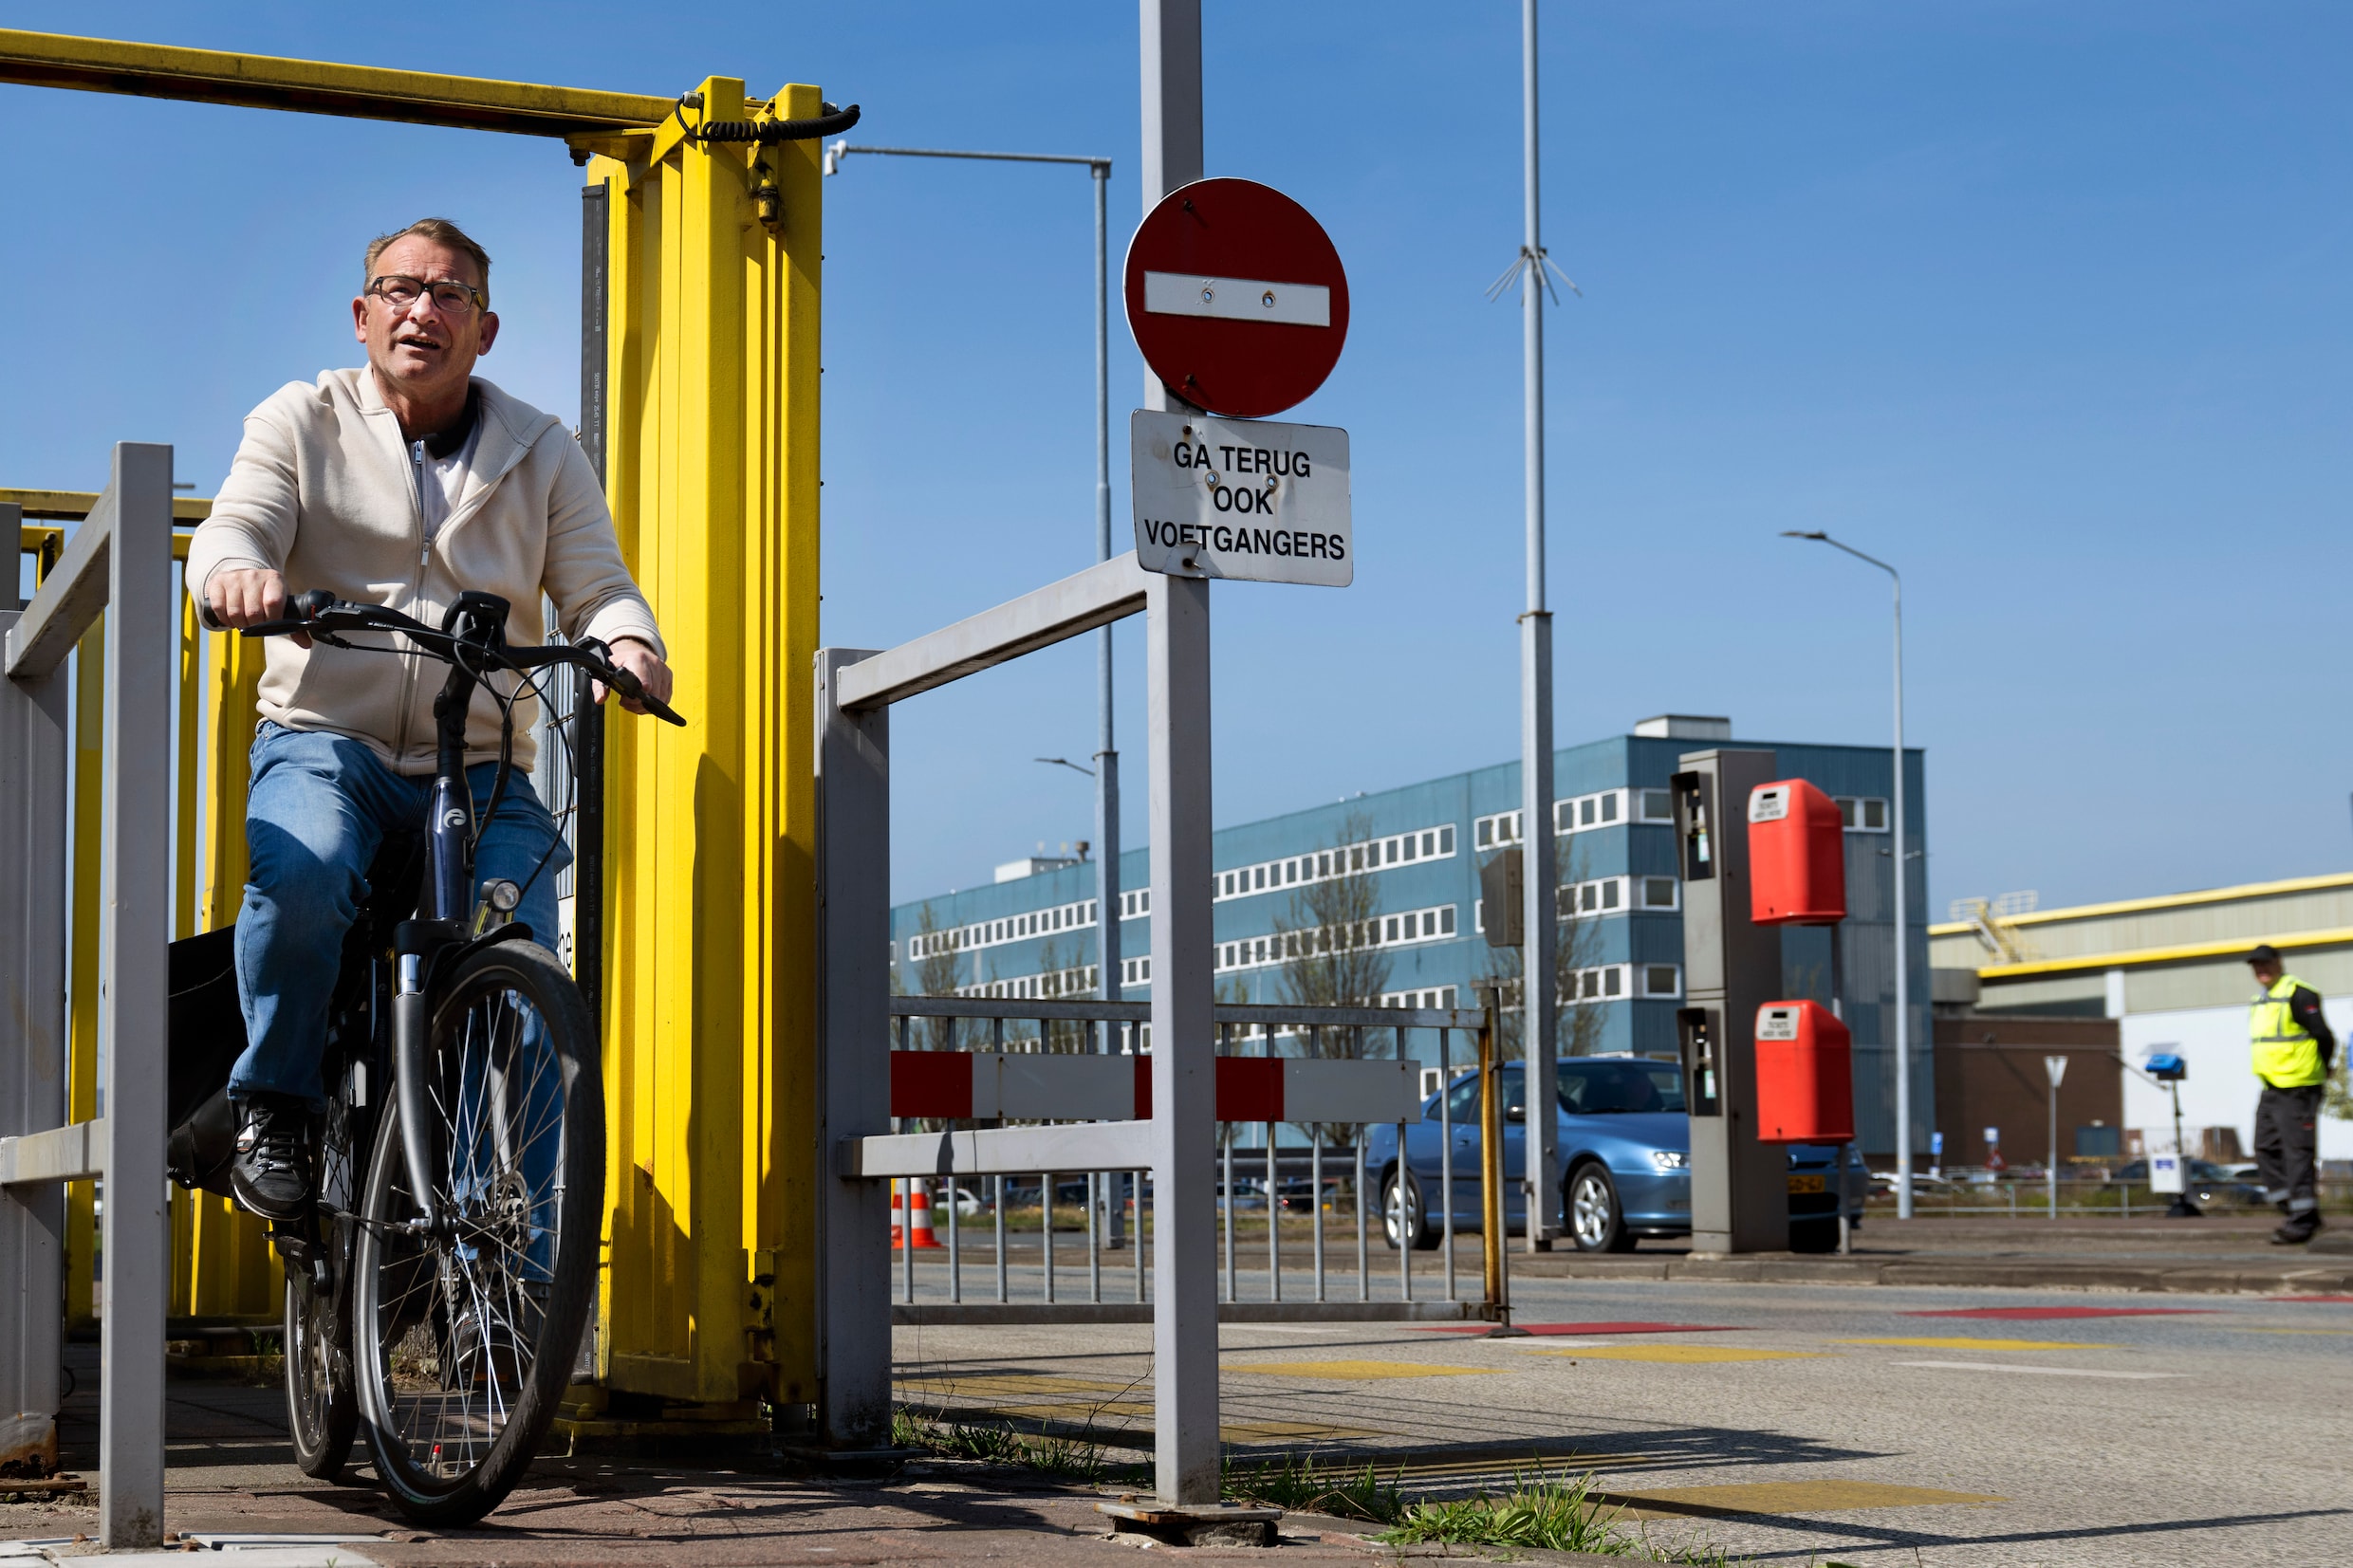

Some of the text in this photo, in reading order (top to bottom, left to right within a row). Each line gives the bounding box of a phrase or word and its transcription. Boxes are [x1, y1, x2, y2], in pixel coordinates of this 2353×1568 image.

[1174, 442, 1310, 478] GA TERUG
[1214, 486, 1273, 515] OOK
[1144, 519, 1345, 561] VOETGANGERS
